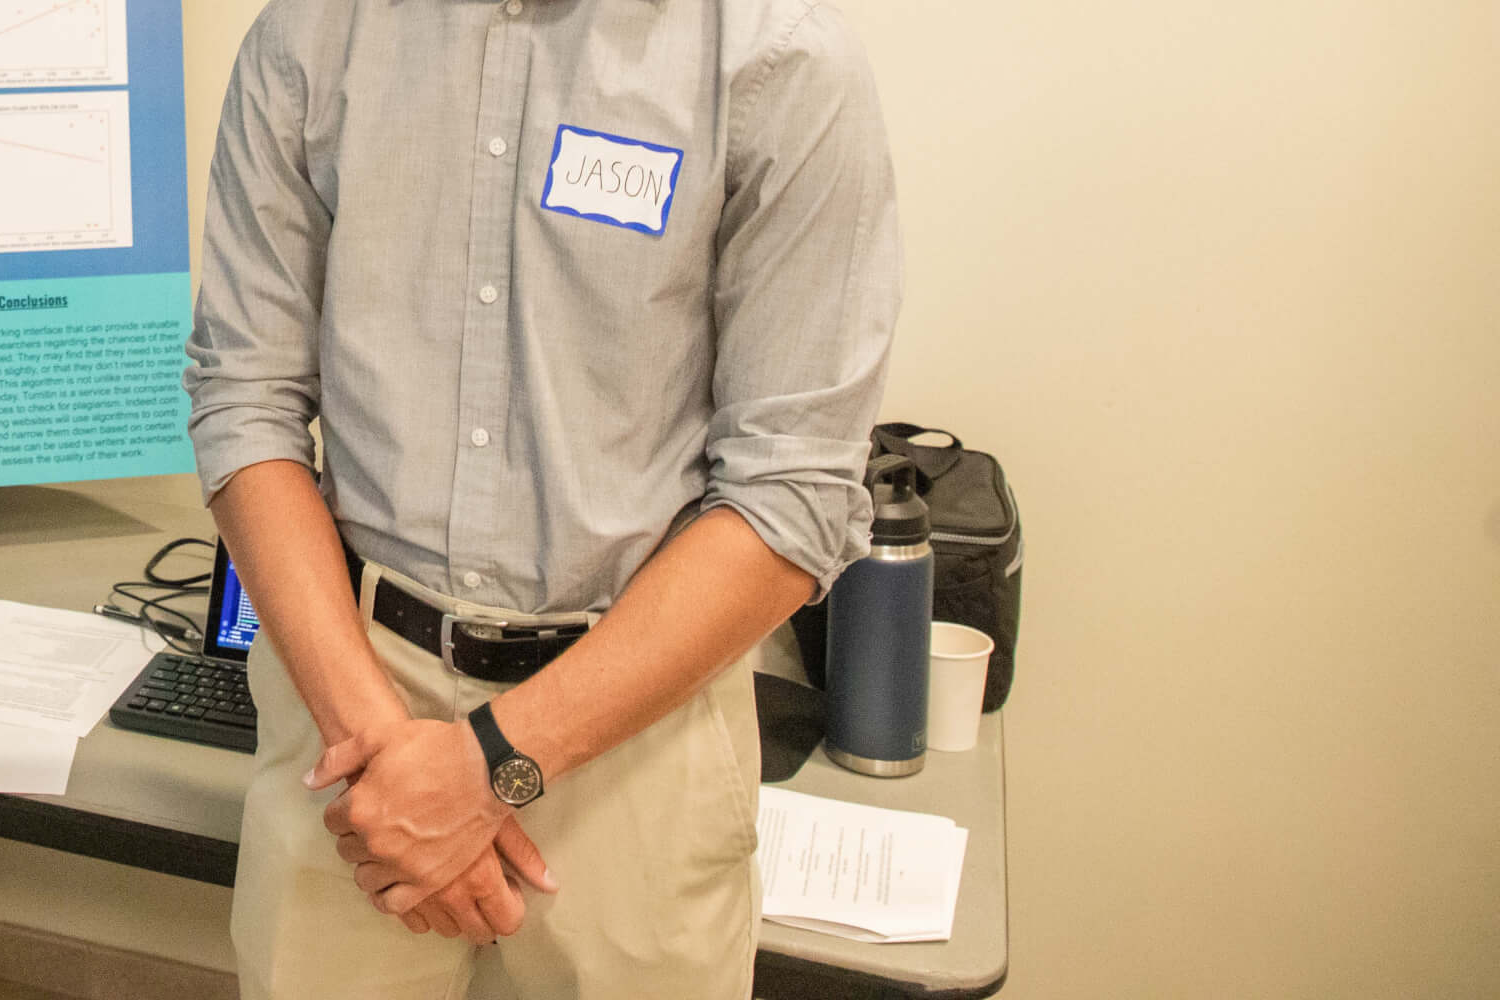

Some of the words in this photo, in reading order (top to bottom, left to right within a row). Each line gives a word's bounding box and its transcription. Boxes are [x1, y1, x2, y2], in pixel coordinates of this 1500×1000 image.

[566, 155, 663, 206] JASON
[24, 326, 63, 335] interface
[105, 323, 138, 333] provide
[107, 334, 145, 344] chances
[21, 378, 64, 389] algorithm
[79, 389, 110, 397] service
[92, 412, 140, 423] algorithms
[130, 434, 182, 445] advantages
[54, 453, 83, 463] quality
